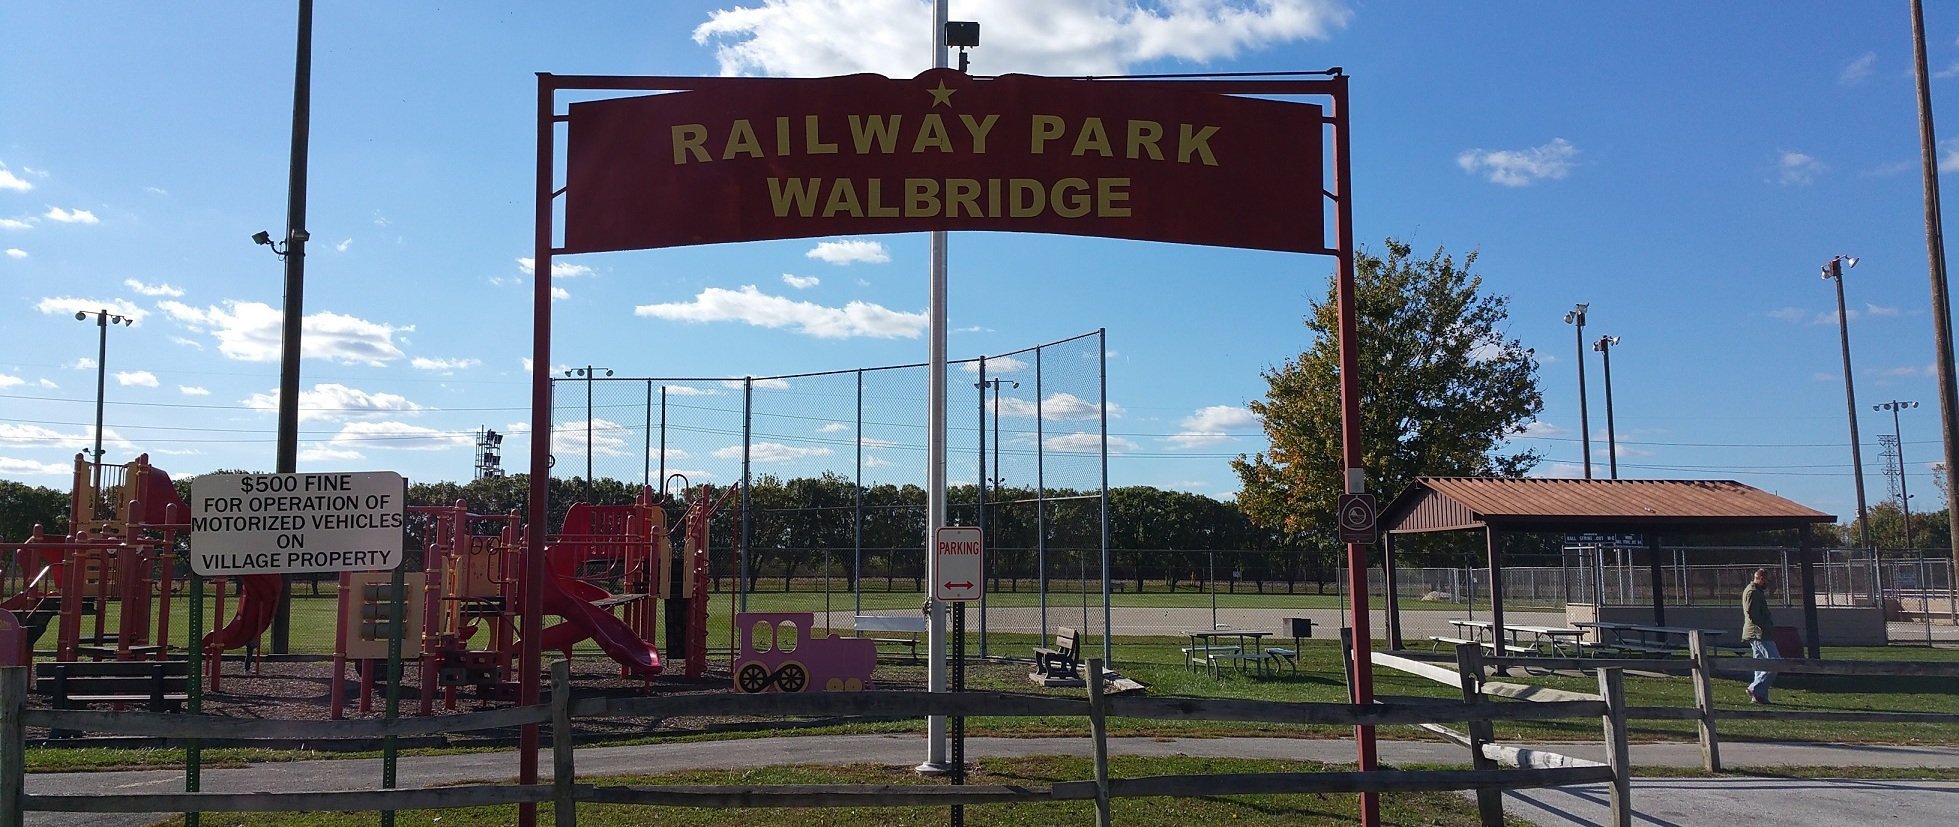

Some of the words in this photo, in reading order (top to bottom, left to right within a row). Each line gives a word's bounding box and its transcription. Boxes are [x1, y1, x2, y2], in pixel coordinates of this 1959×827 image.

[671, 113, 1000, 165] RAILWAY
[1030, 114, 1222, 167] PARK
[767, 177, 1132, 218] WALBRIDGE
[241, 475, 297, 494] $500
[305, 475, 352, 491] FINE
[204, 497, 242, 512] FOR
[249, 495, 358, 512] OPERATION
[365, 494, 390, 510] OF
[192, 516, 305, 532] MOTORIZED
[312, 513, 403, 529] VEHICLES
[276, 533, 304, 549] ON
[939, 541, 980, 555] PARKING
[202, 553, 281, 569] VILLAGE
[287, 550, 391, 567] PROPERTY
